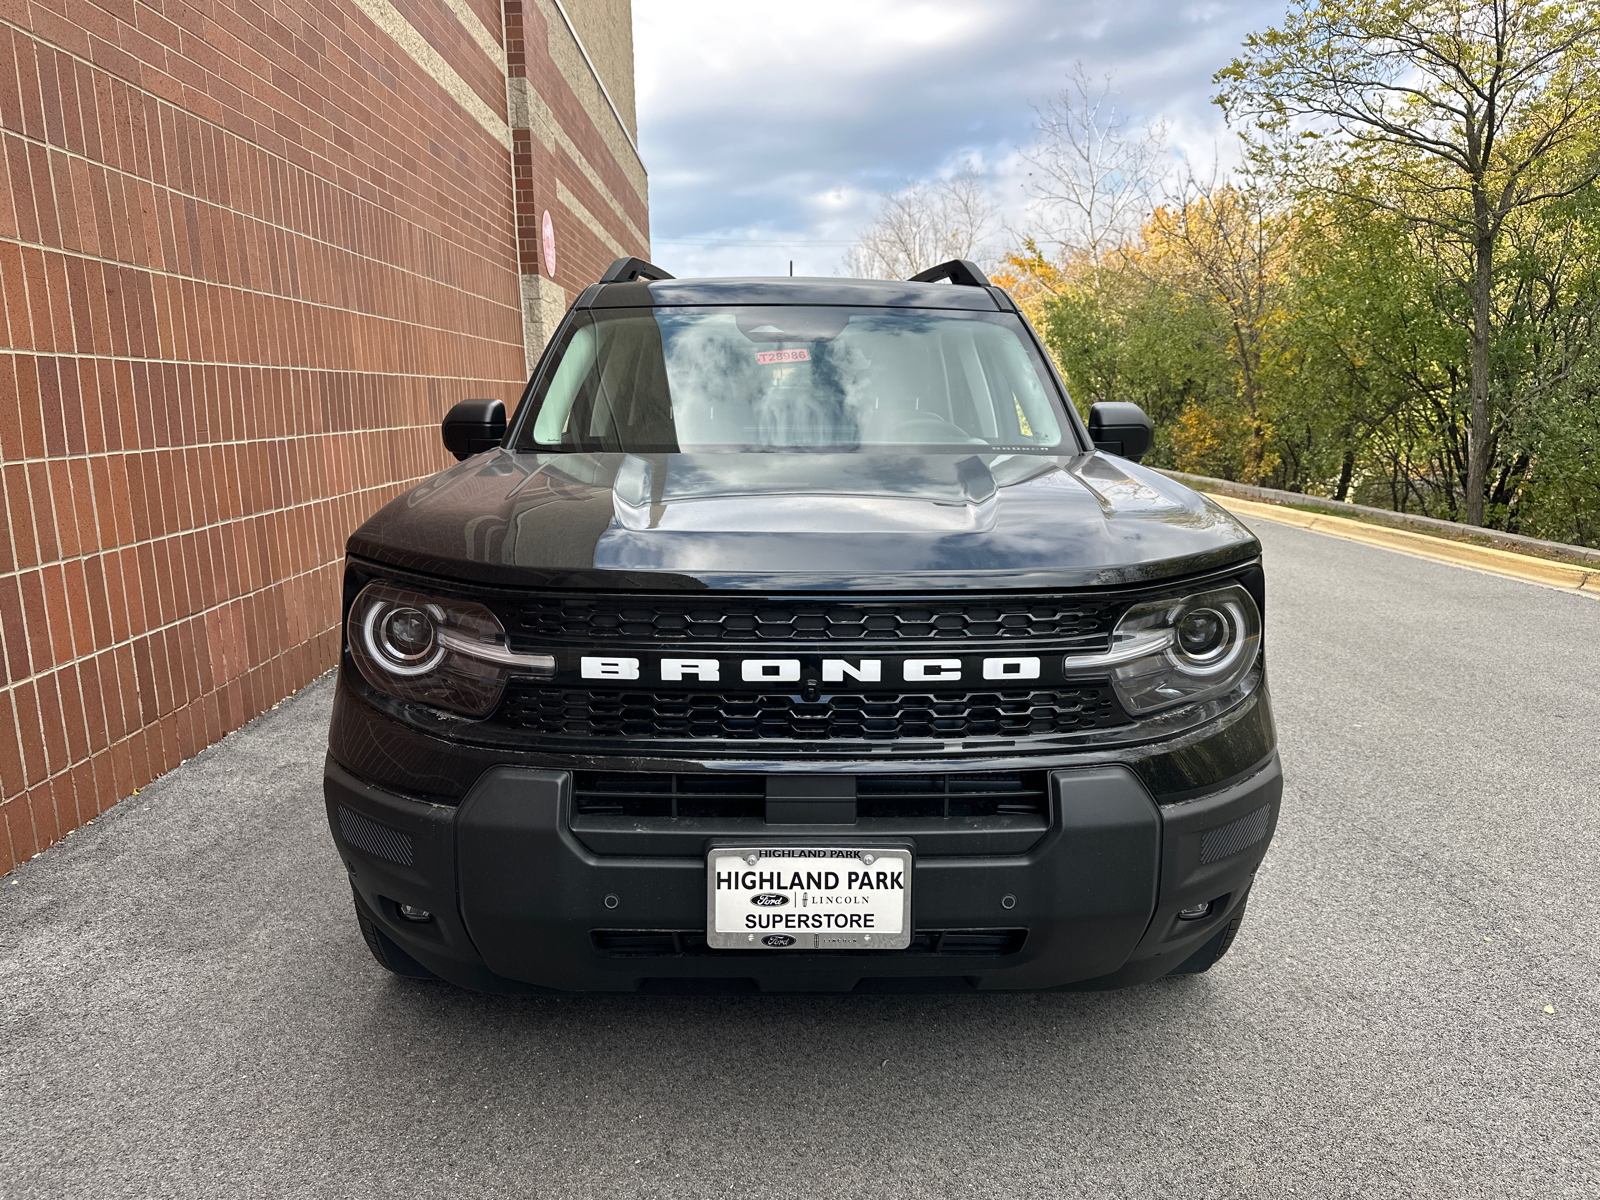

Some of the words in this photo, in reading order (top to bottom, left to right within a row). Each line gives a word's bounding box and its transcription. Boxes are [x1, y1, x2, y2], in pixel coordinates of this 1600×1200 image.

[580, 656, 1041, 682] BRONCO
[758, 849, 827, 858] HIGHLAND
[830, 850, 862, 859] PARK
[716, 871, 840, 890] HIGHLAND
[847, 871, 904, 890] PARK
[756, 894, 784, 906] Ford
[811, 896, 869, 905] LINCOLN
[744, 913, 875, 929] SUPERSTORE
[767, 935, 790, 946] Ford
